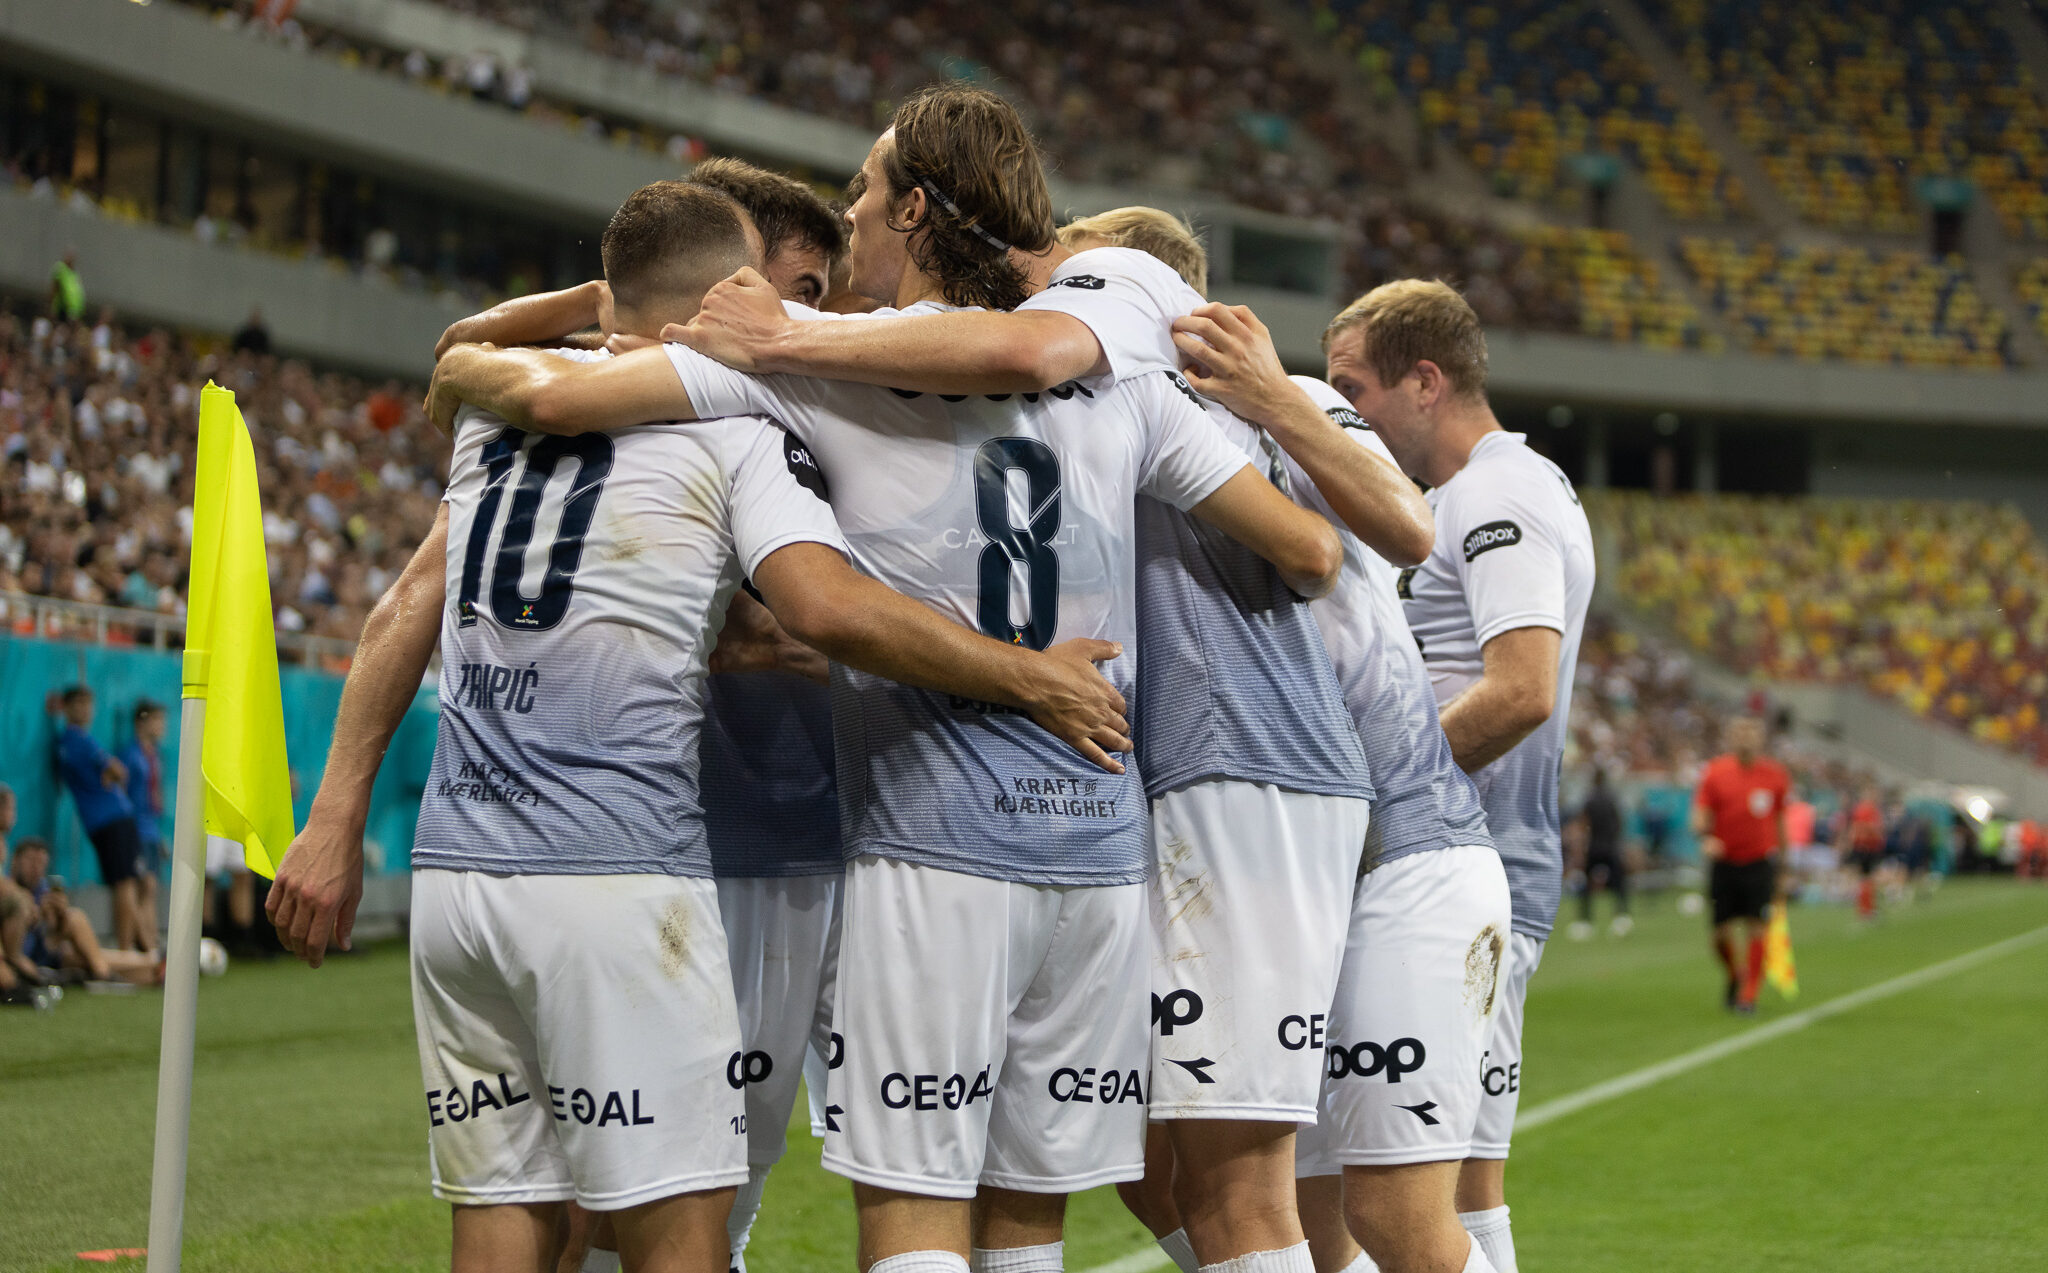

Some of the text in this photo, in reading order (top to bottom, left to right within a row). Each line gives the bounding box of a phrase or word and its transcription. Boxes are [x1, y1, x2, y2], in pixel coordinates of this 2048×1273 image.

[458, 426, 615, 631] 10
[1464, 527, 1517, 557] altibox
[973, 437, 1062, 652] 8
[1013, 776, 1098, 796] KRAFT OG
[993, 795, 1117, 818] KJÆRLIGHET
